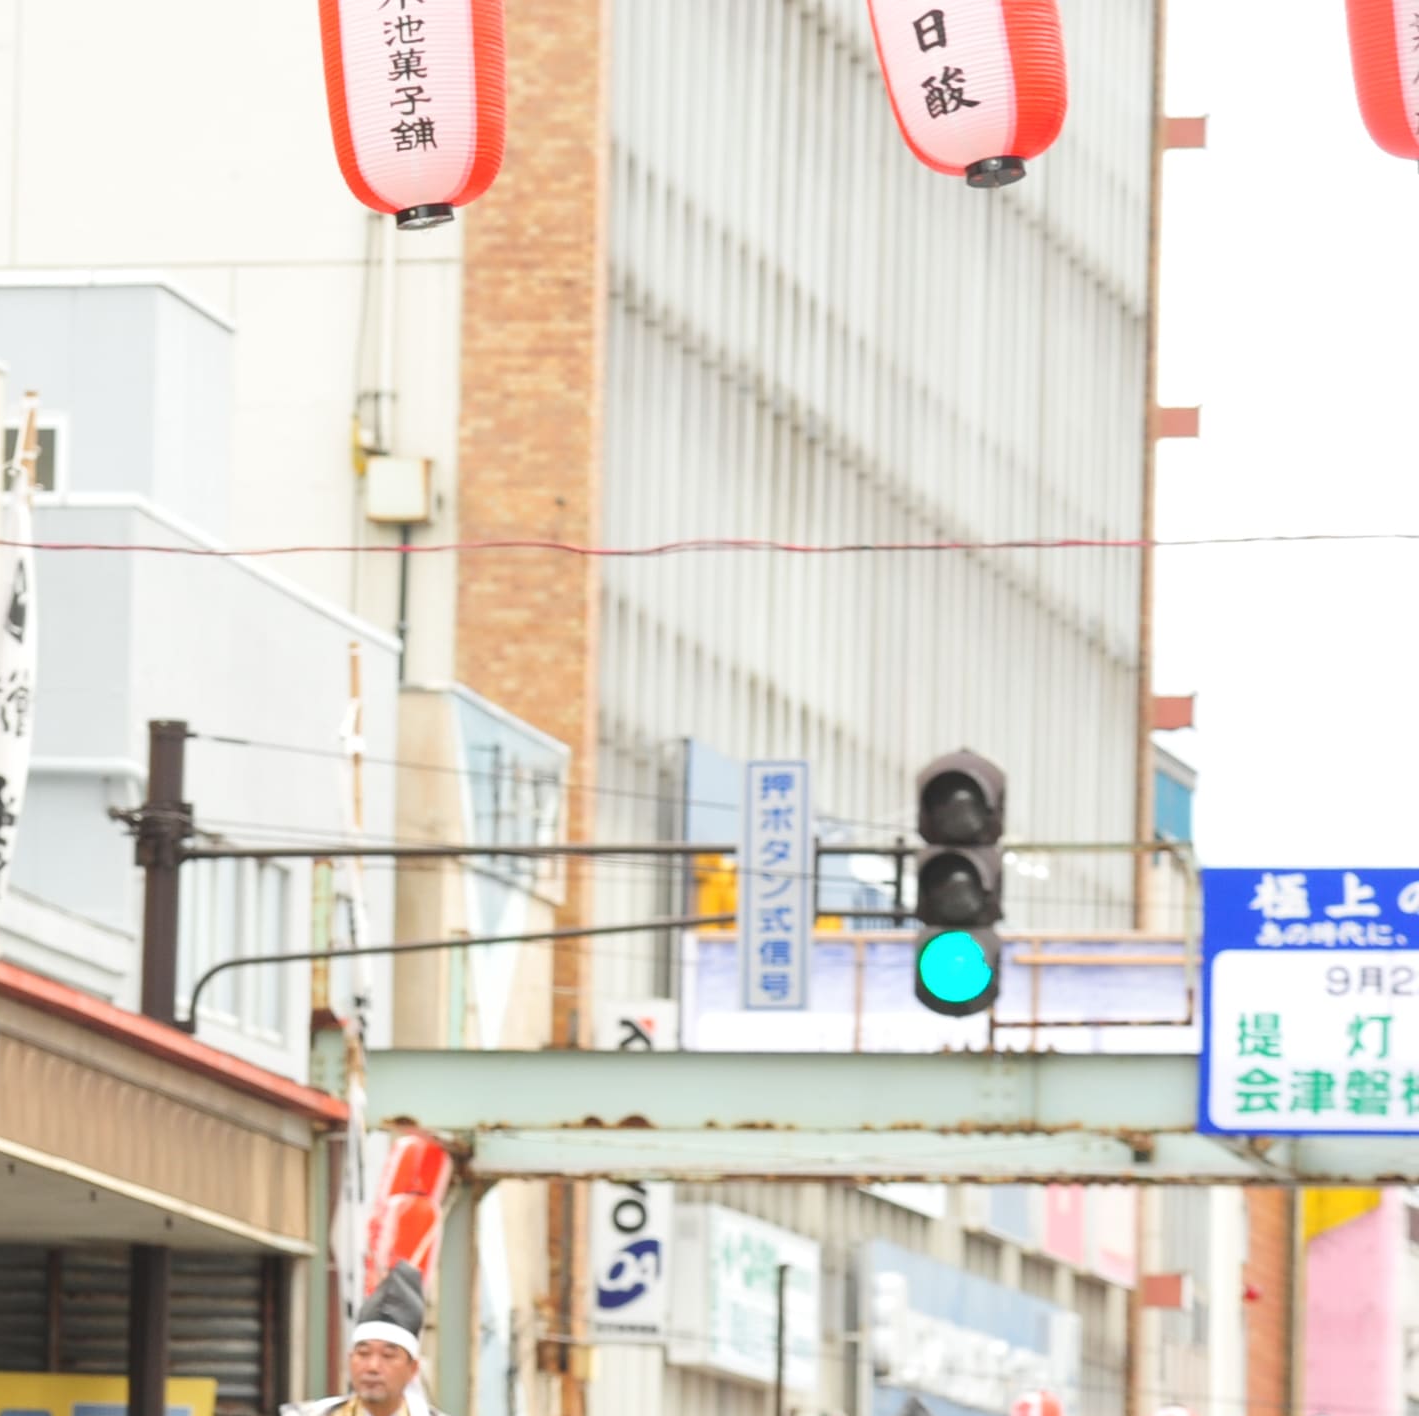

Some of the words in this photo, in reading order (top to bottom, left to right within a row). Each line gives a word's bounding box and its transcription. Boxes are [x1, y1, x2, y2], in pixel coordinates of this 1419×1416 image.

[378, 0, 438, 152] 池菓子舗
[913, 9, 981, 119] 日酸
[759, 773, 795, 1000] 押ボタン式信号
[1326, 965, 1419, 996] 9月2
